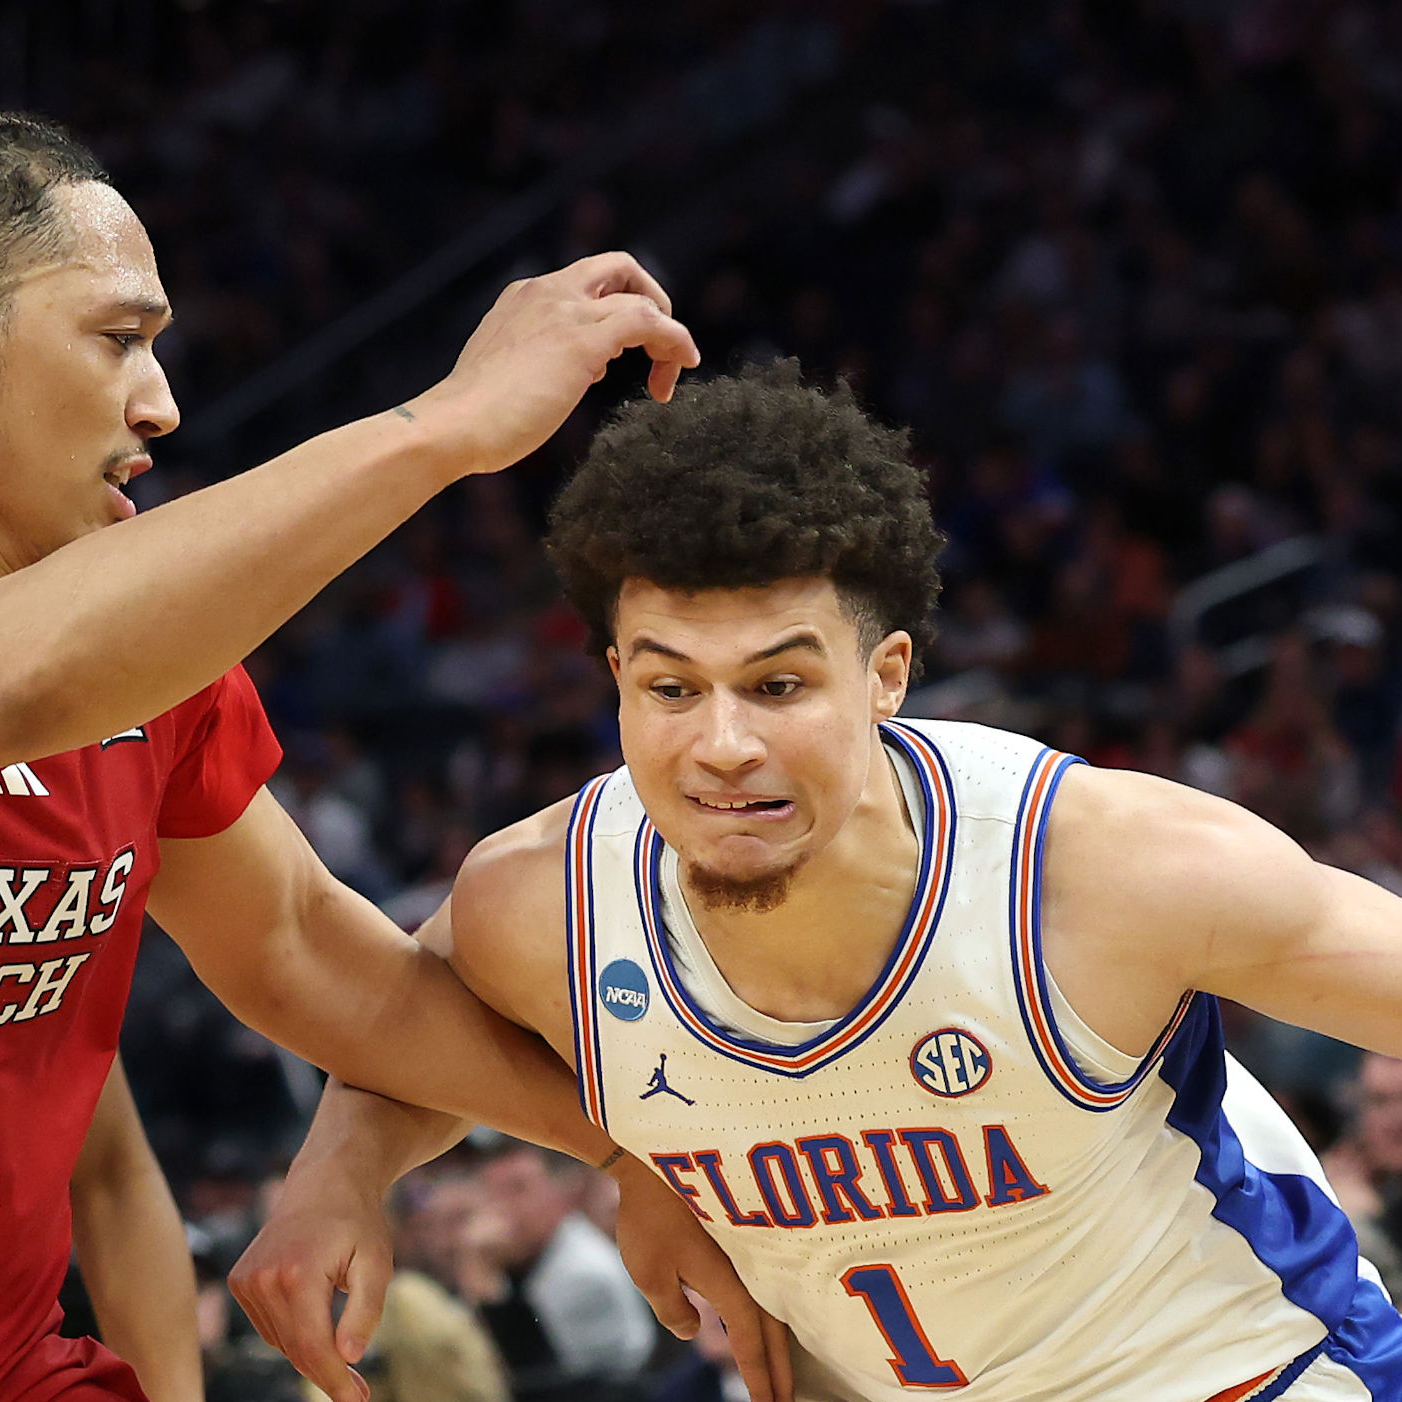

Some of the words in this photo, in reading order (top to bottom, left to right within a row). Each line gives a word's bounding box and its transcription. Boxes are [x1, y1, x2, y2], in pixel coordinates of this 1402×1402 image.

[606, 986, 646, 1007] NCAA
[916, 1034, 986, 1096] SEC
[650, 1124, 1051, 1229] FLORIDA
[839, 1264, 969, 1388] 1
